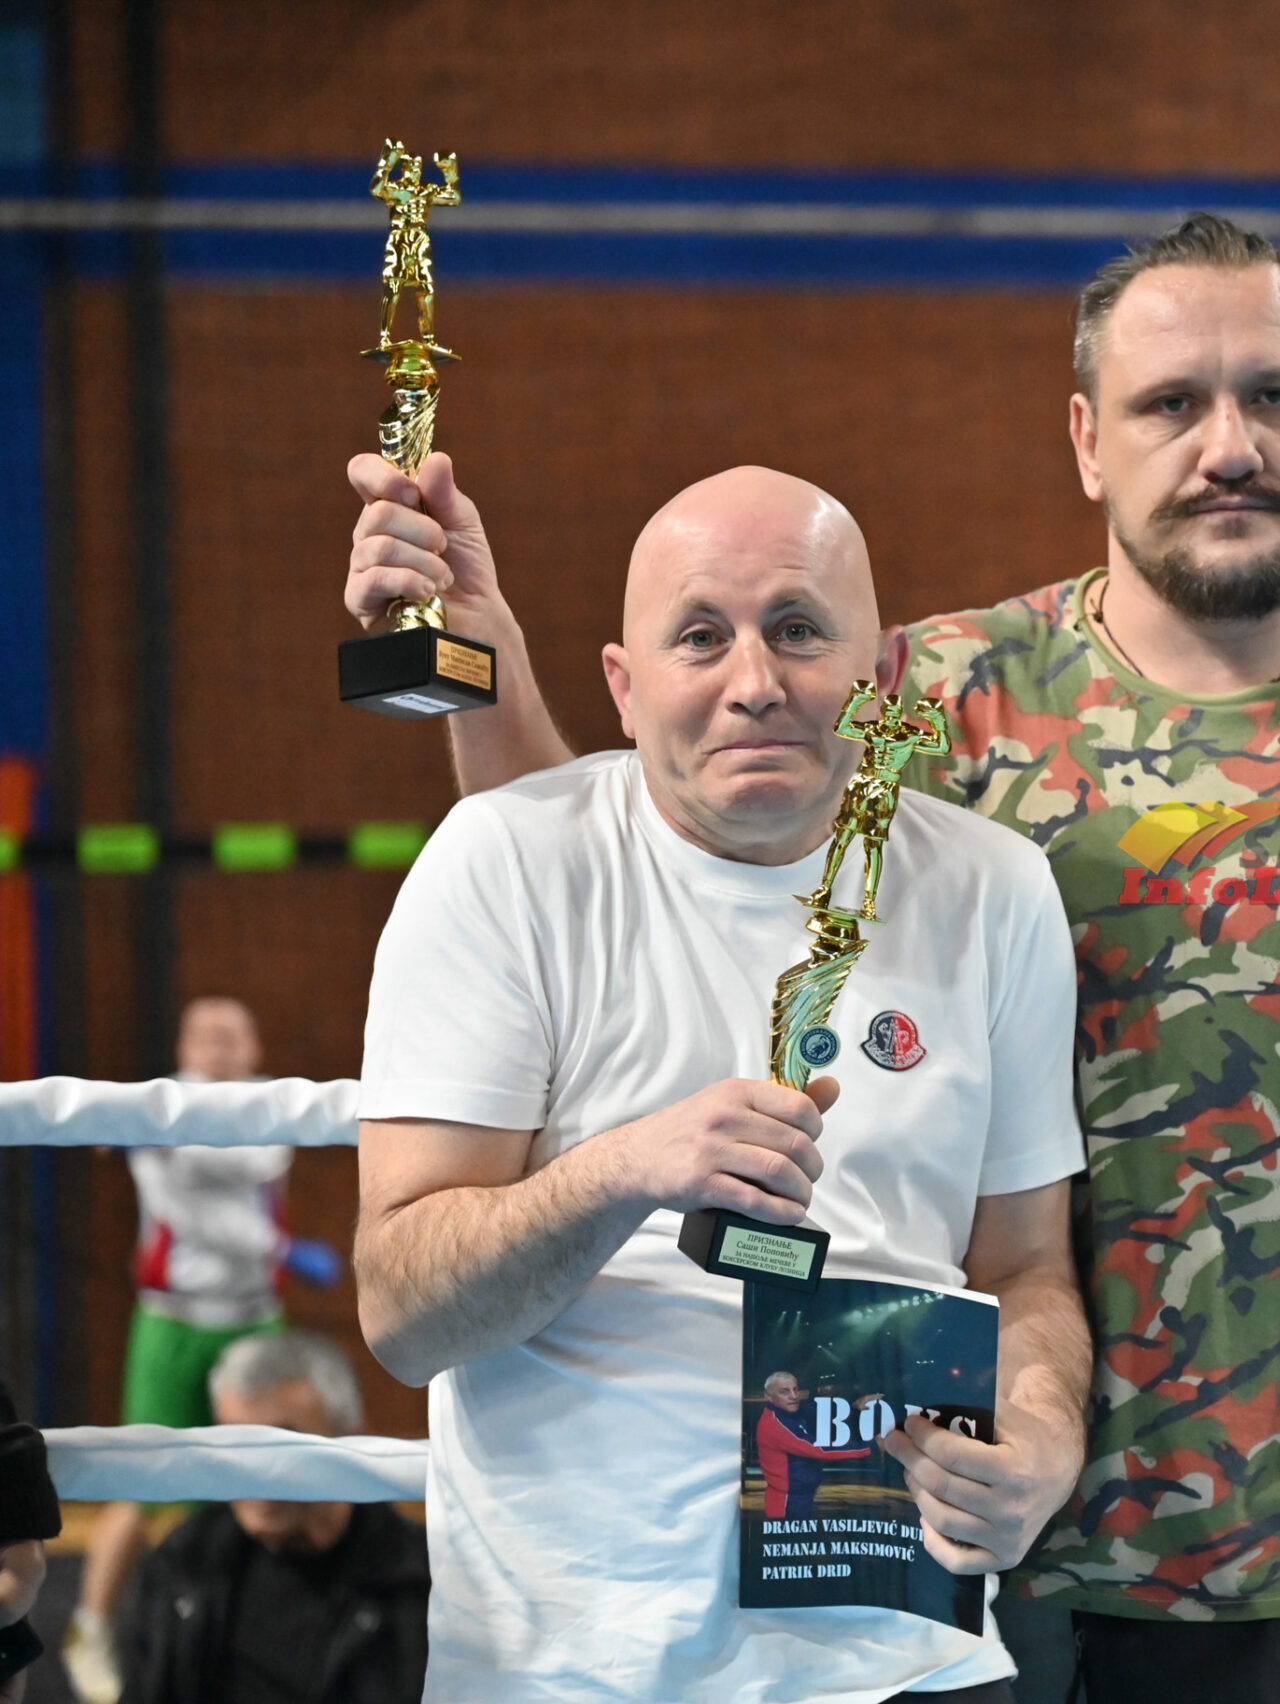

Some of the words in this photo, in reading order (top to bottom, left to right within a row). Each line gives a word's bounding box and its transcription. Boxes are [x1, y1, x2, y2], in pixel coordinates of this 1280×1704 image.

[747, 1234, 793, 1250] ПРИЗНАЊЕ
[736, 1241, 759, 1252] Саши
[760, 1245, 799, 1261] Поповићу
[763, 1520, 817, 1534] DRAGAN
[822, 1519, 898, 1536] VASILJEVIĆ
[762, 1542, 827, 1557] NEMANJA
[830, 1542, 915, 1562] MAKSIMOVIĆ
[762, 1565, 813, 1580] PATRIK
[817, 1564, 851, 1578] DRID
